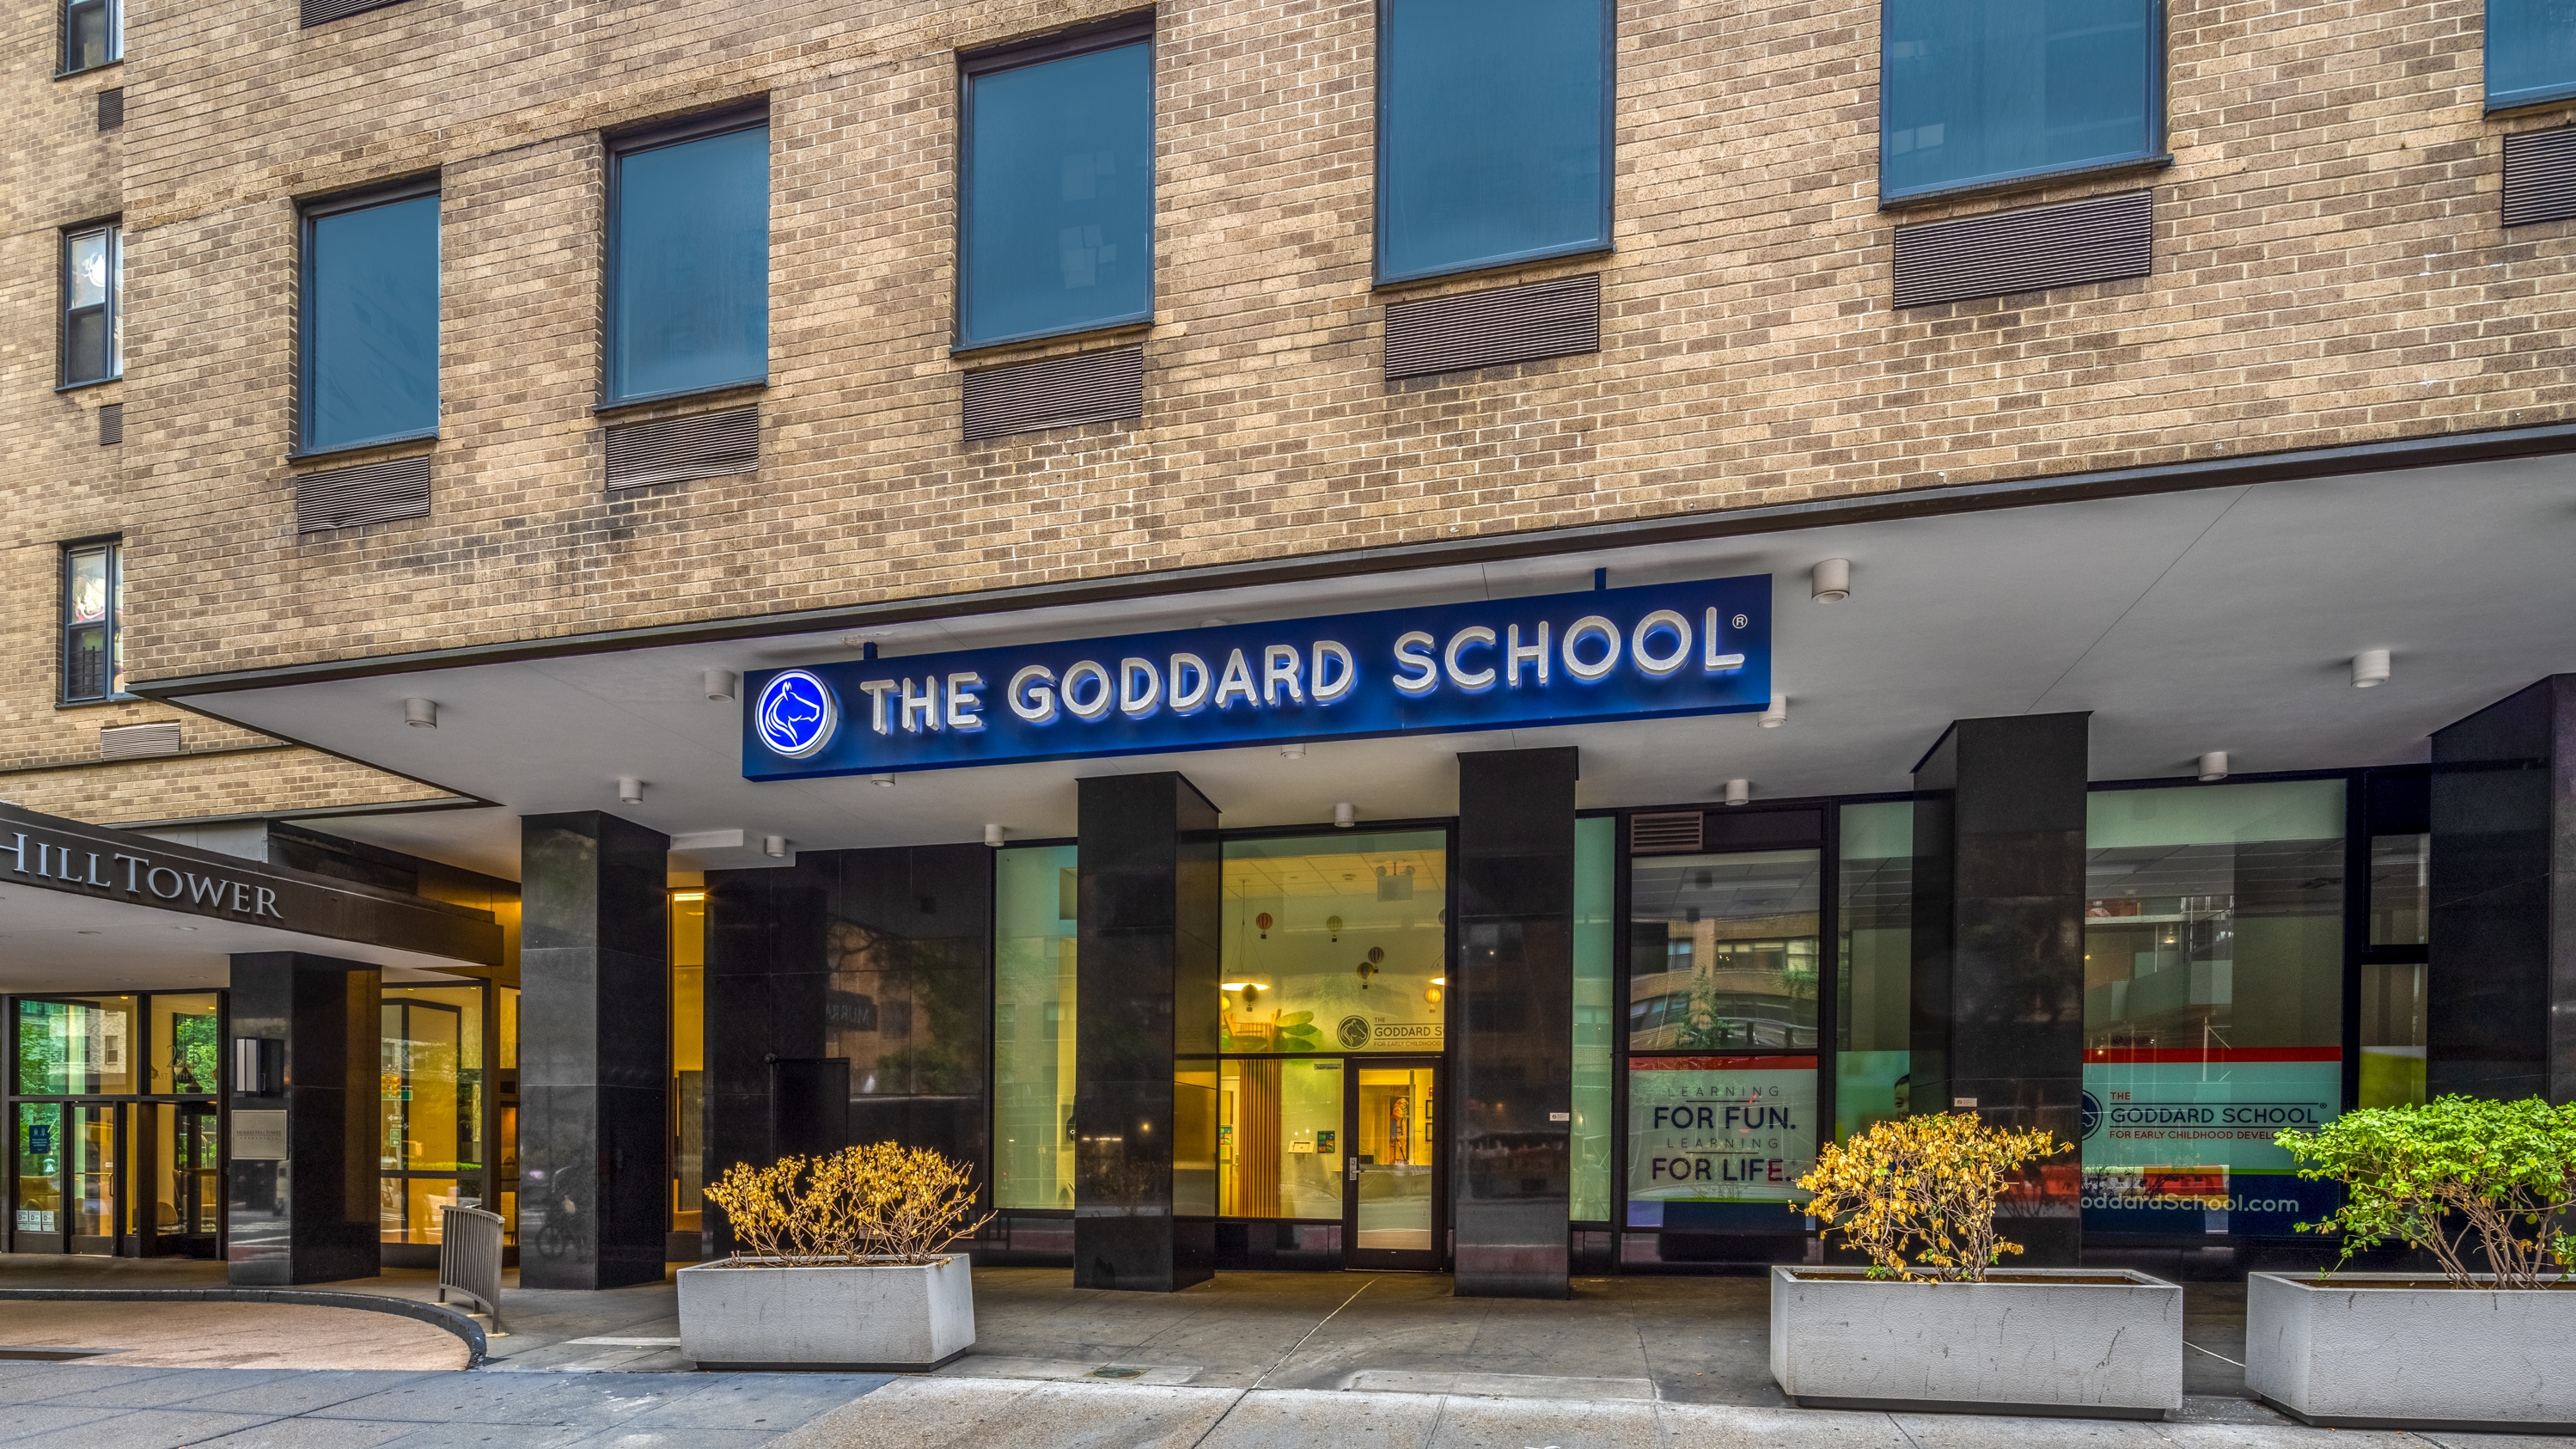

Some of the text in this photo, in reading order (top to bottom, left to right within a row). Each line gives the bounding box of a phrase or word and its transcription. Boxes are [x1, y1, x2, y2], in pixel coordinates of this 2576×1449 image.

[860, 671, 983, 735] THE
[1008, 640, 1355, 723] GODDARD
[113, 853, 284, 919] TOWER
[1375, 1027, 1431, 1036] GODDARD
[1668, 1086, 1779, 1097] LEARNING
[2110, 1091, 2131, 1100] THE
[1654, 1106, 1797, 1129] FOR FUN.
[2110, 1107, 2214, 1123] GODDARD
[2109, 1130, 2132, 1140] FOR
[2134, 1130, 2165, 1140] EARLY
[2168, 1130, 2234, 1140] CHILDHOOD
[1667, 1138, 1779, 1149] LEARNING
[1651, 1157, 1712, 1181] FOR
[2080, 1192, 2299, 1212] oddardSchool.com
